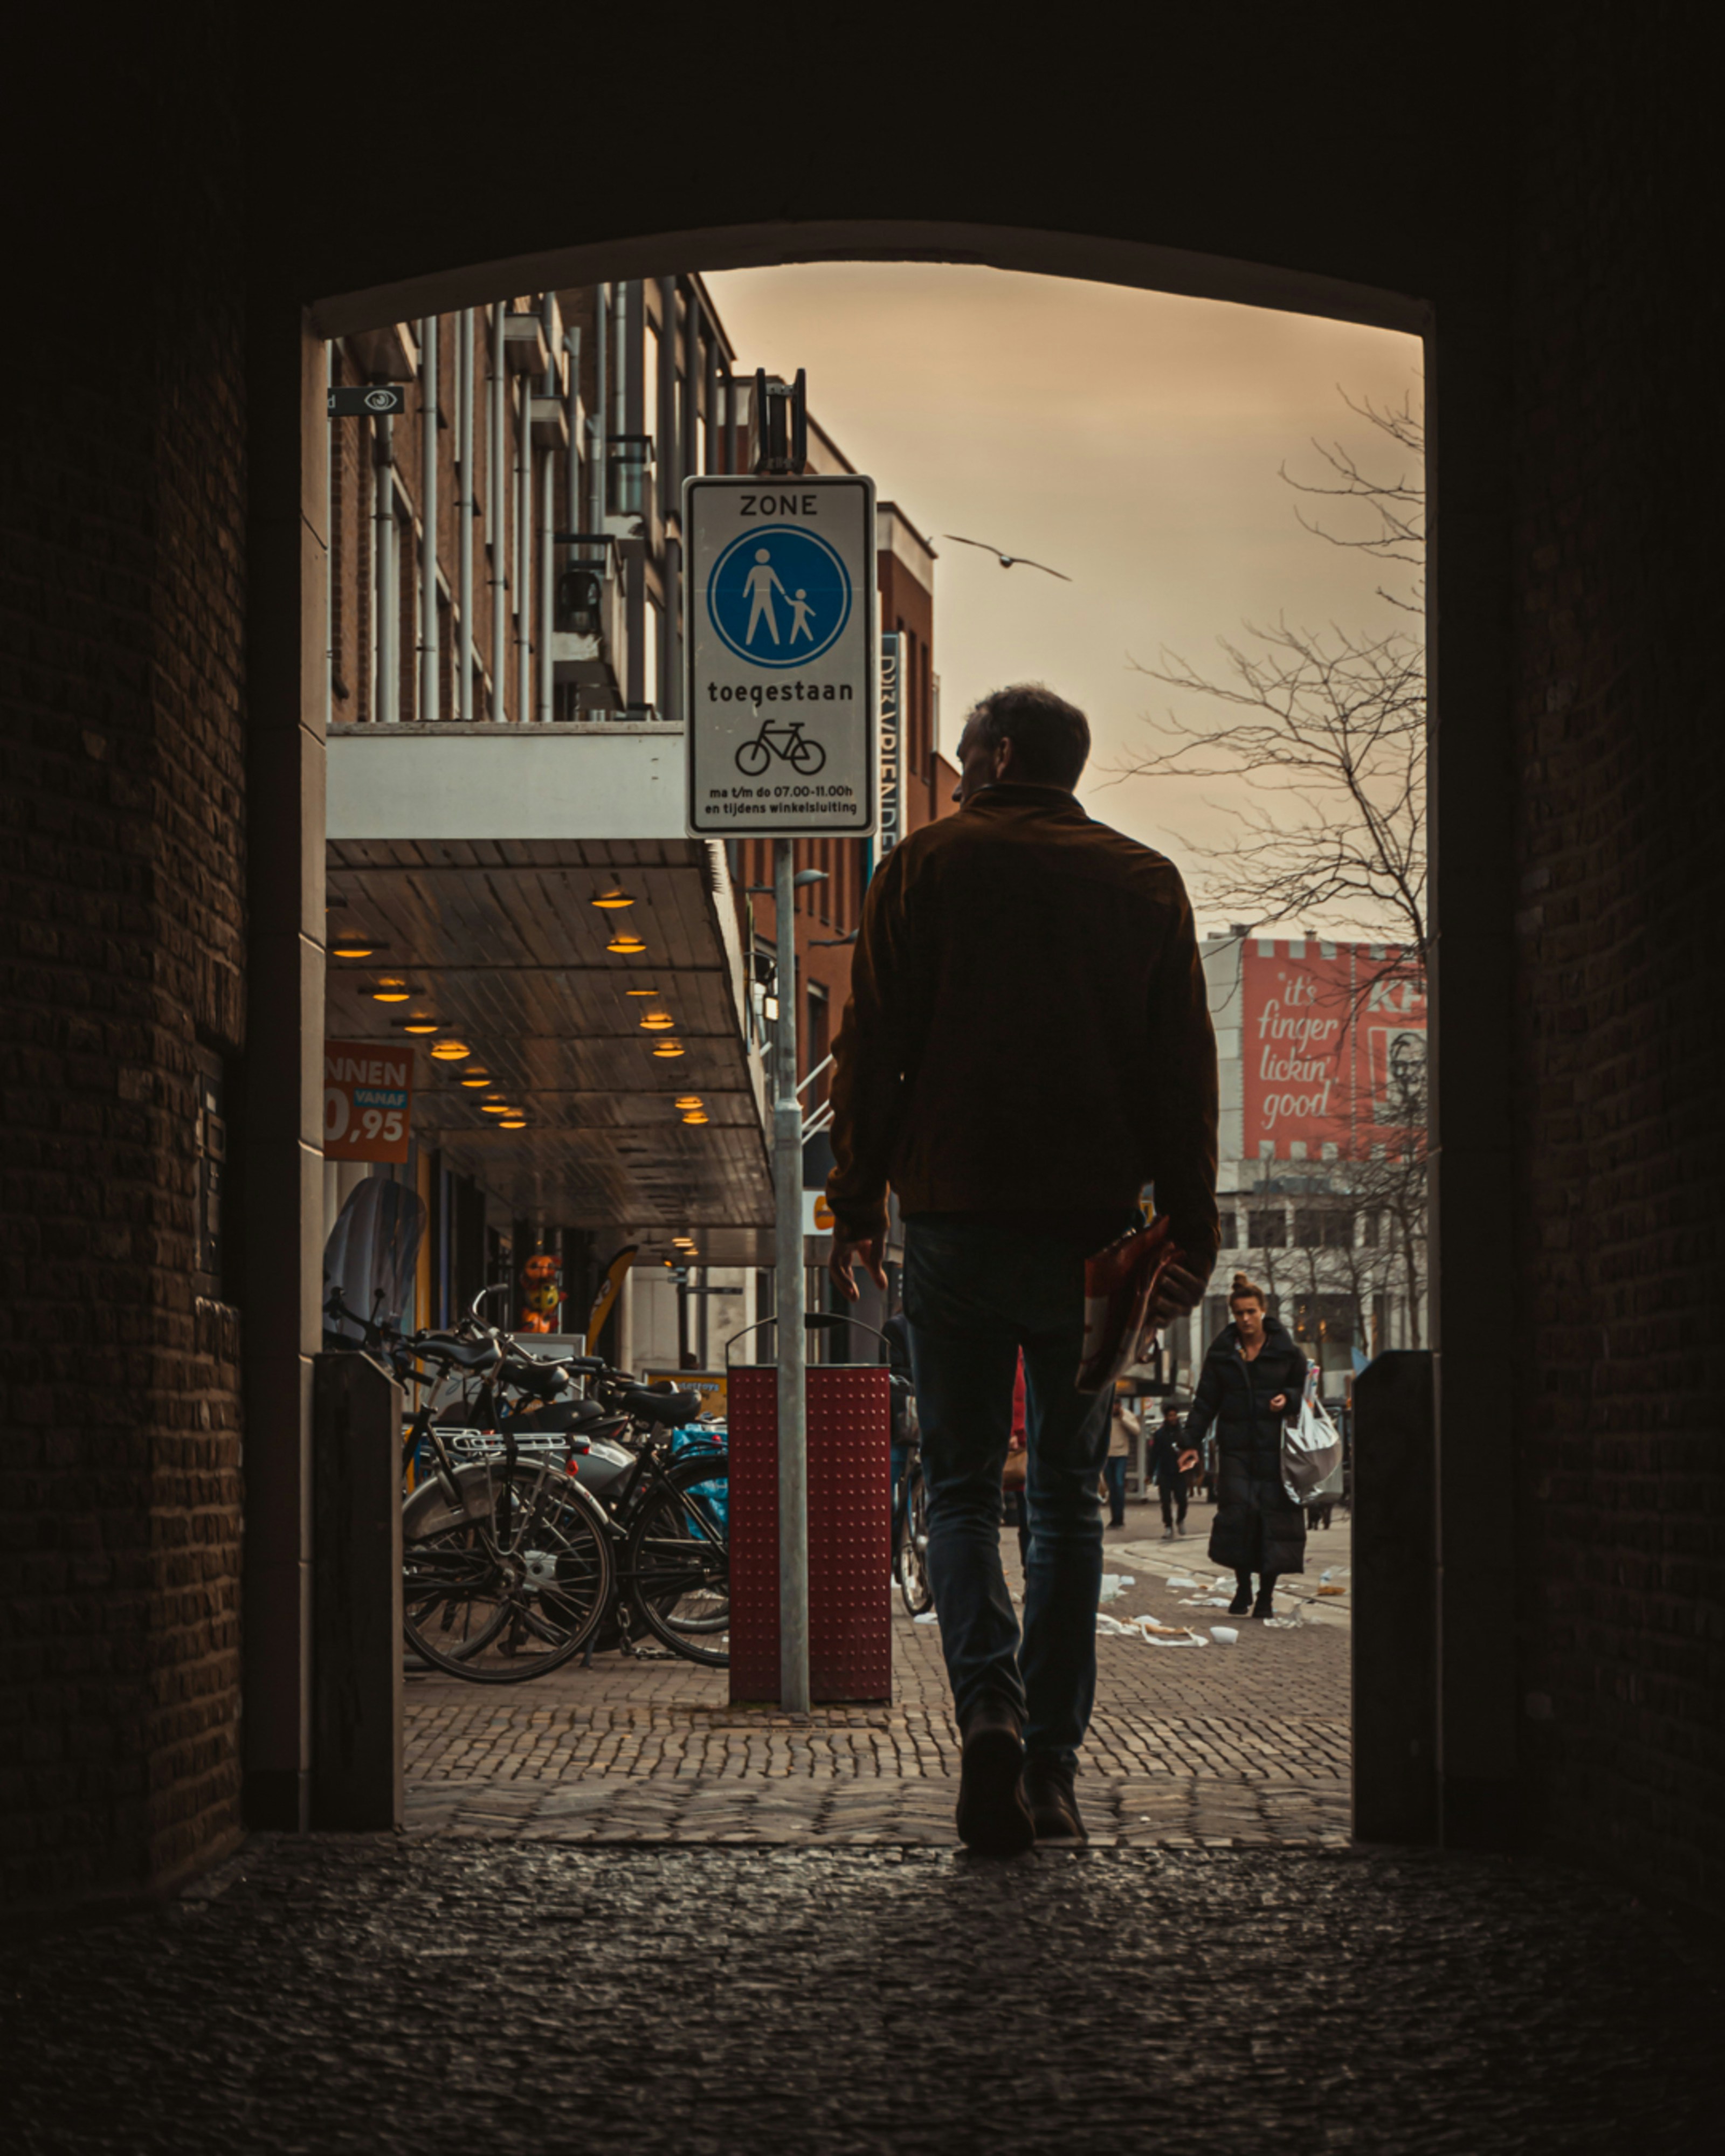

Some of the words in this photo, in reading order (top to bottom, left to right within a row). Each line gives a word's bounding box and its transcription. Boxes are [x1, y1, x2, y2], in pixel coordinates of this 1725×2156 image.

[740, 495, 817, 516] ZONE
[708, 681, 853, 708] toegestaan
[710, 789, 728, 798] ma
[732, 786, 753, 798] t/m
[756, 787, 771, 797] do
[774, 785, 853, 797] 07.00-11.00h
[705, 805, 720, 814] en
[723, 803, 766, 817] tijdens
[769, 803, 857, 815] winkelsluiting
[1366, 979, 1427, 1013] KF
[1257, 999, 1338, 1053] finger
[1260, 1044, 1331, 1082] lickin'
[355, 1090, 405, 1106] VANAF
